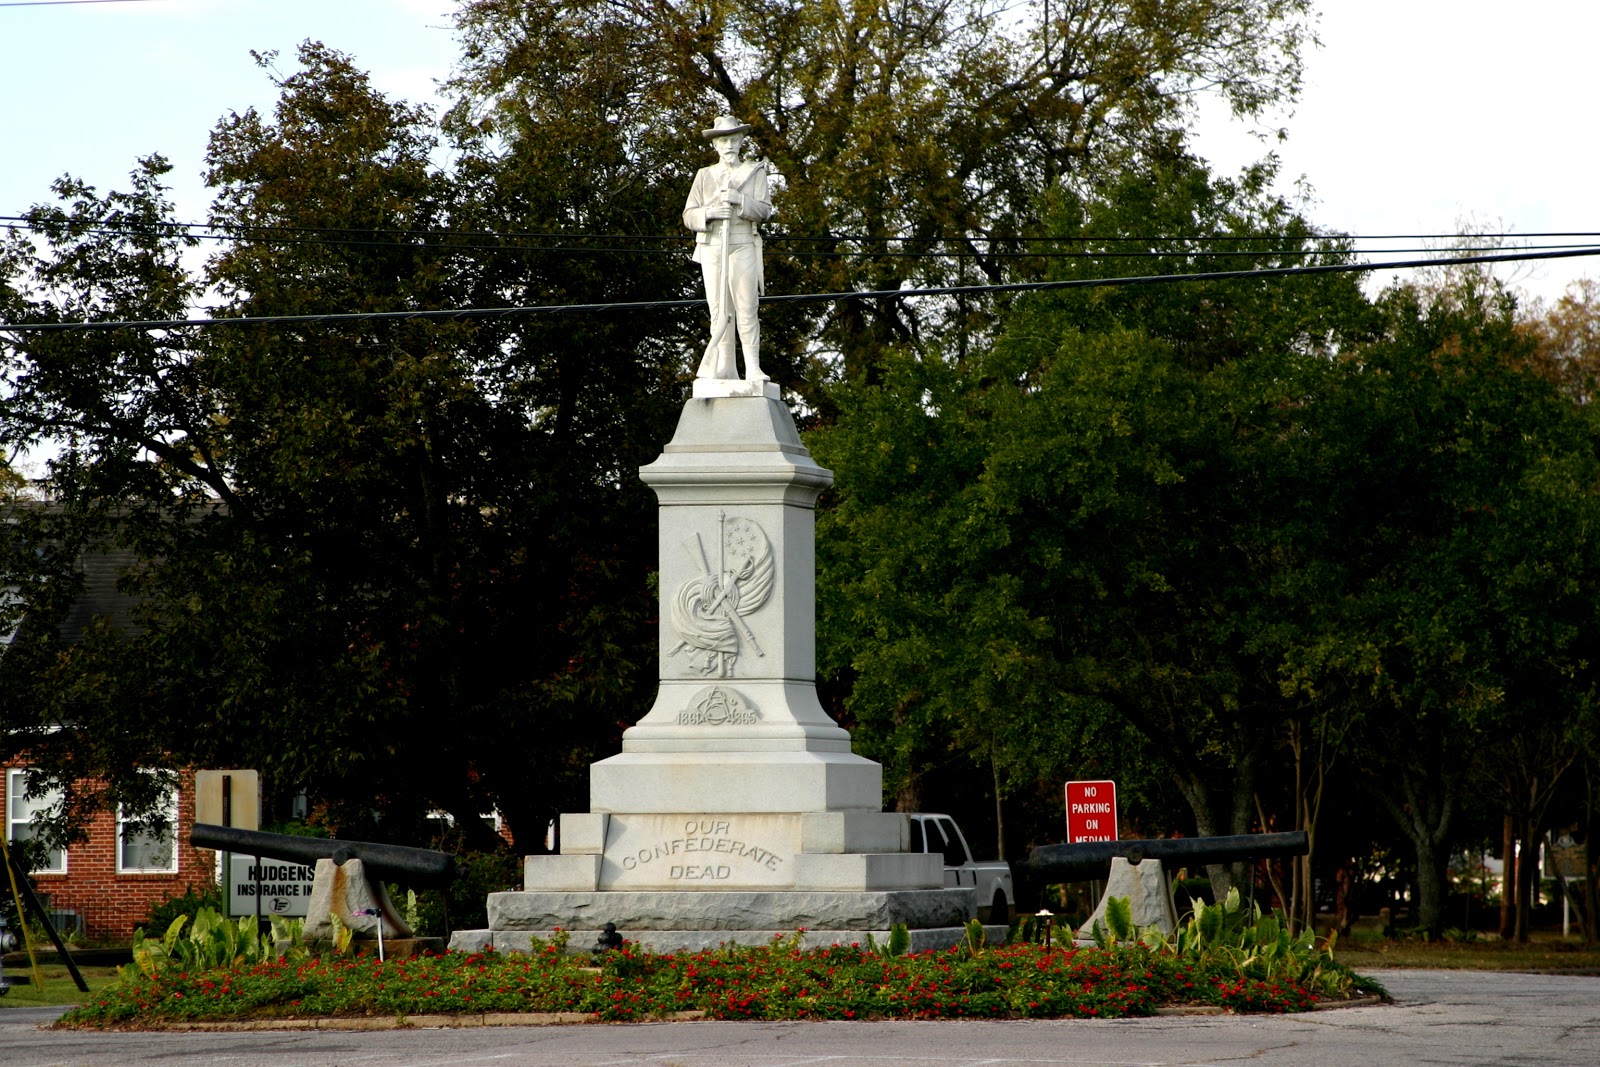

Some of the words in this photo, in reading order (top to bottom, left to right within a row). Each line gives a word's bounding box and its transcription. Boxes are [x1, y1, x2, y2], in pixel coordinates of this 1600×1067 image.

[1084, 786, 1097, 797] NO
[1072, 802, 1111, 814] PARKING
[684, 820, 730, 835] OUR
[1086, 819, 1098, 830] ON
[622, 837, 783, 872] CONFEDERATE
[248, 865, 315, 881] HUDGENS
[669, 865, 731, 880] DEAD
